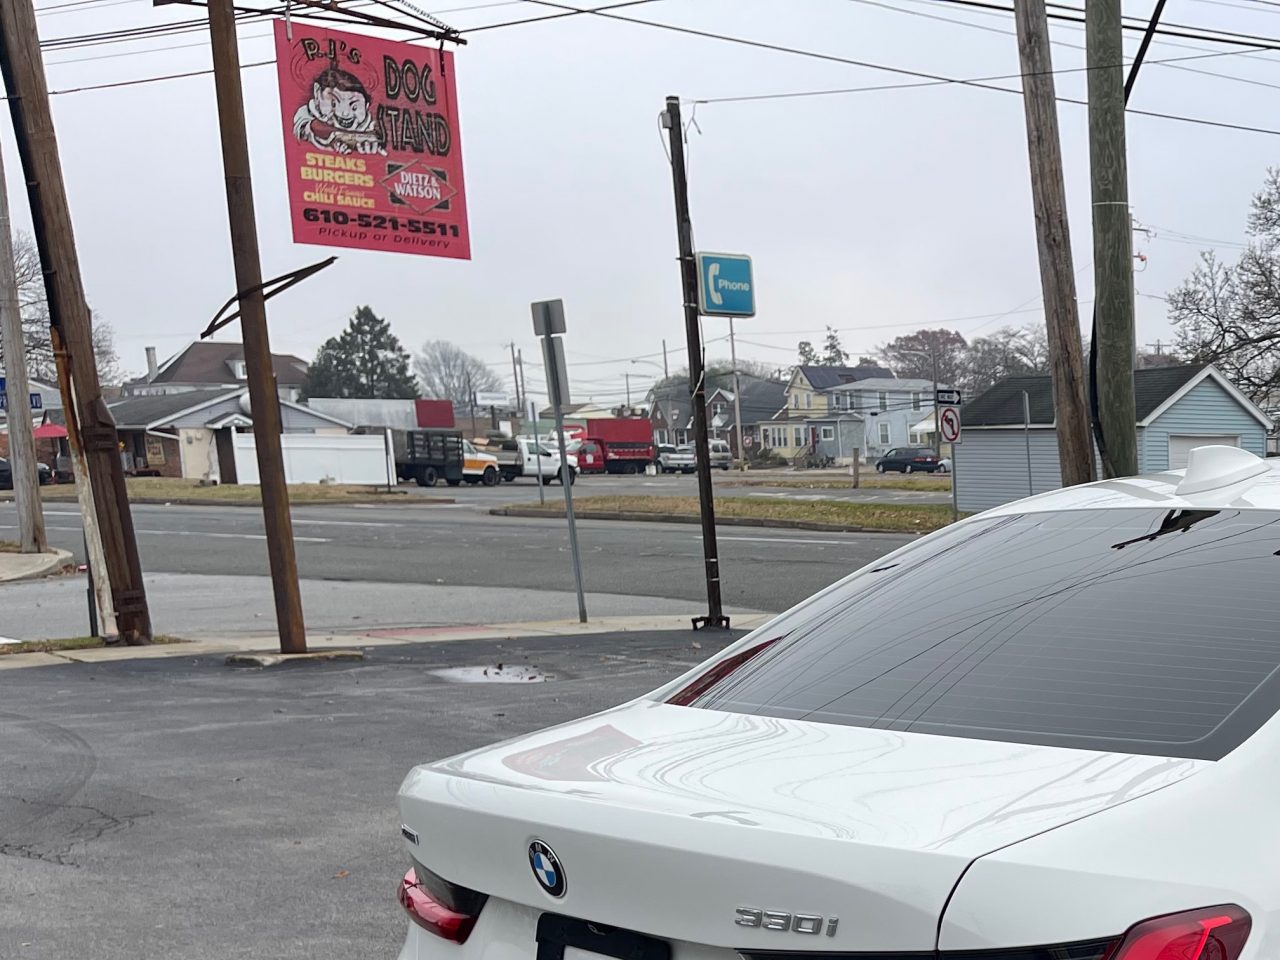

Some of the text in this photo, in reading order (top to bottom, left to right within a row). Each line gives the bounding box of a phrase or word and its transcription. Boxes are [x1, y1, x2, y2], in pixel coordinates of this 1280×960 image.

[383, 55, 436, 105] DOG
[377, 104, 451, 157] STAND
[305, 152, 367, 172] STEAKS
[300, 166, 374, 188] BURGERS
[303, 191, 375, 208] CHILI SAUCE
[394, 183, 441, 200] WATSON
[303, 208, 459, 237] 610-521-5511
[373, 233, 388, 242] or
[393, 234, 450, 250] Delivery
[718, 279, 750, 292] Phone
[735, 907, 839, 937] 330i
